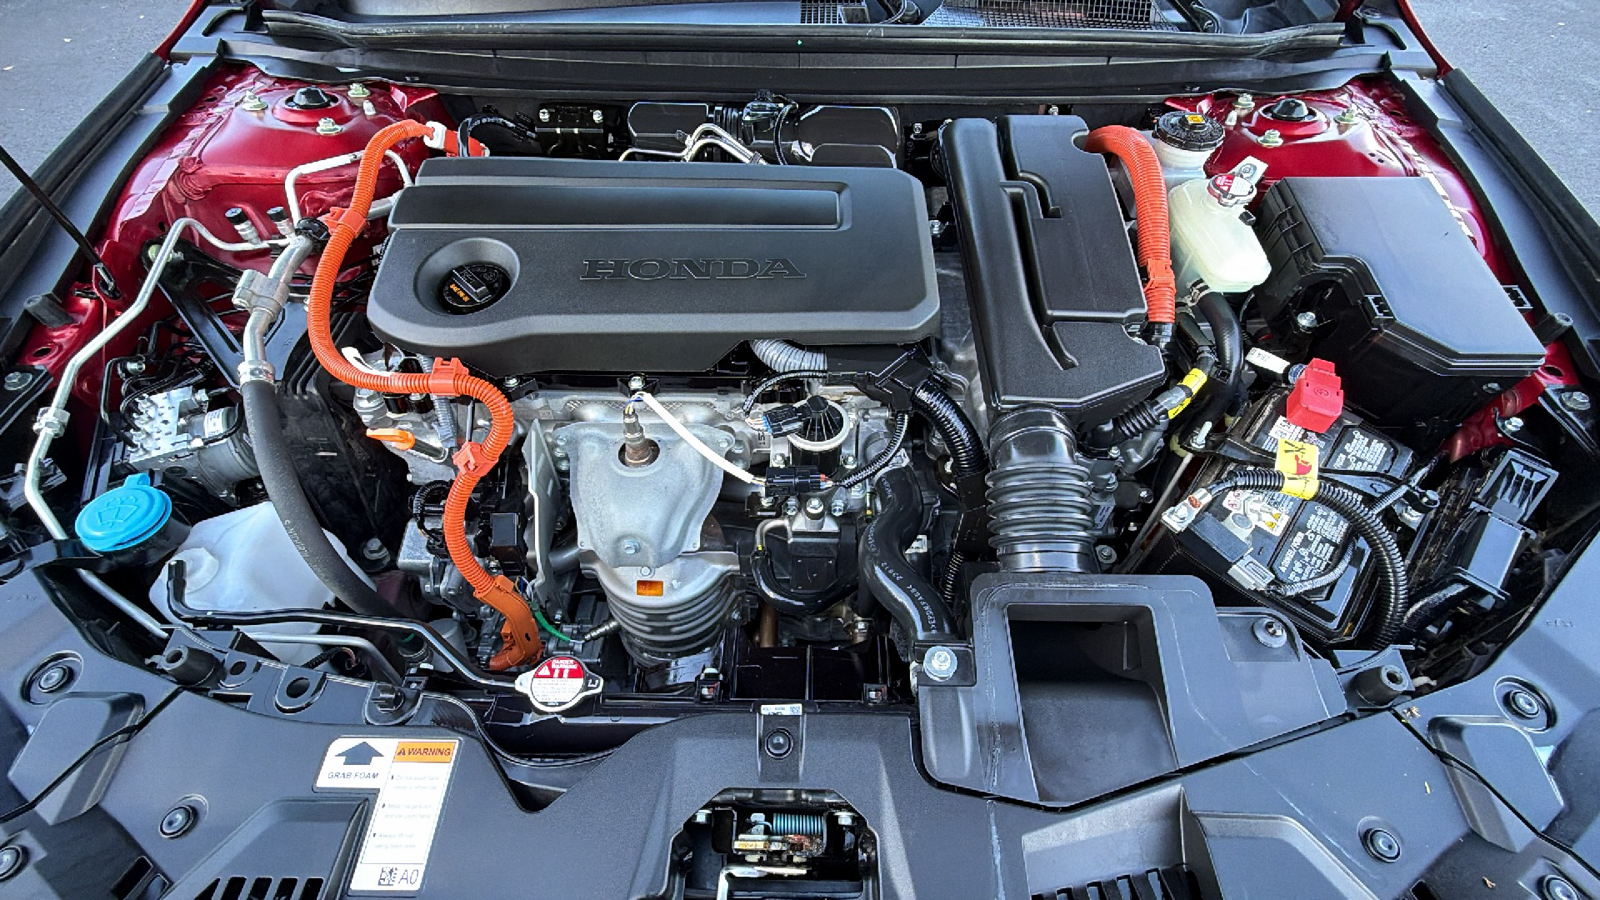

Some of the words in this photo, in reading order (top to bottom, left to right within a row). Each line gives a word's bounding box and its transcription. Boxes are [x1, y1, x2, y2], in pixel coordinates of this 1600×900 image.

[579, 258, 807, 280] HONDA
[407, 748, 451, 756] WARNING
[327, 771, 353, 779] GRAB
